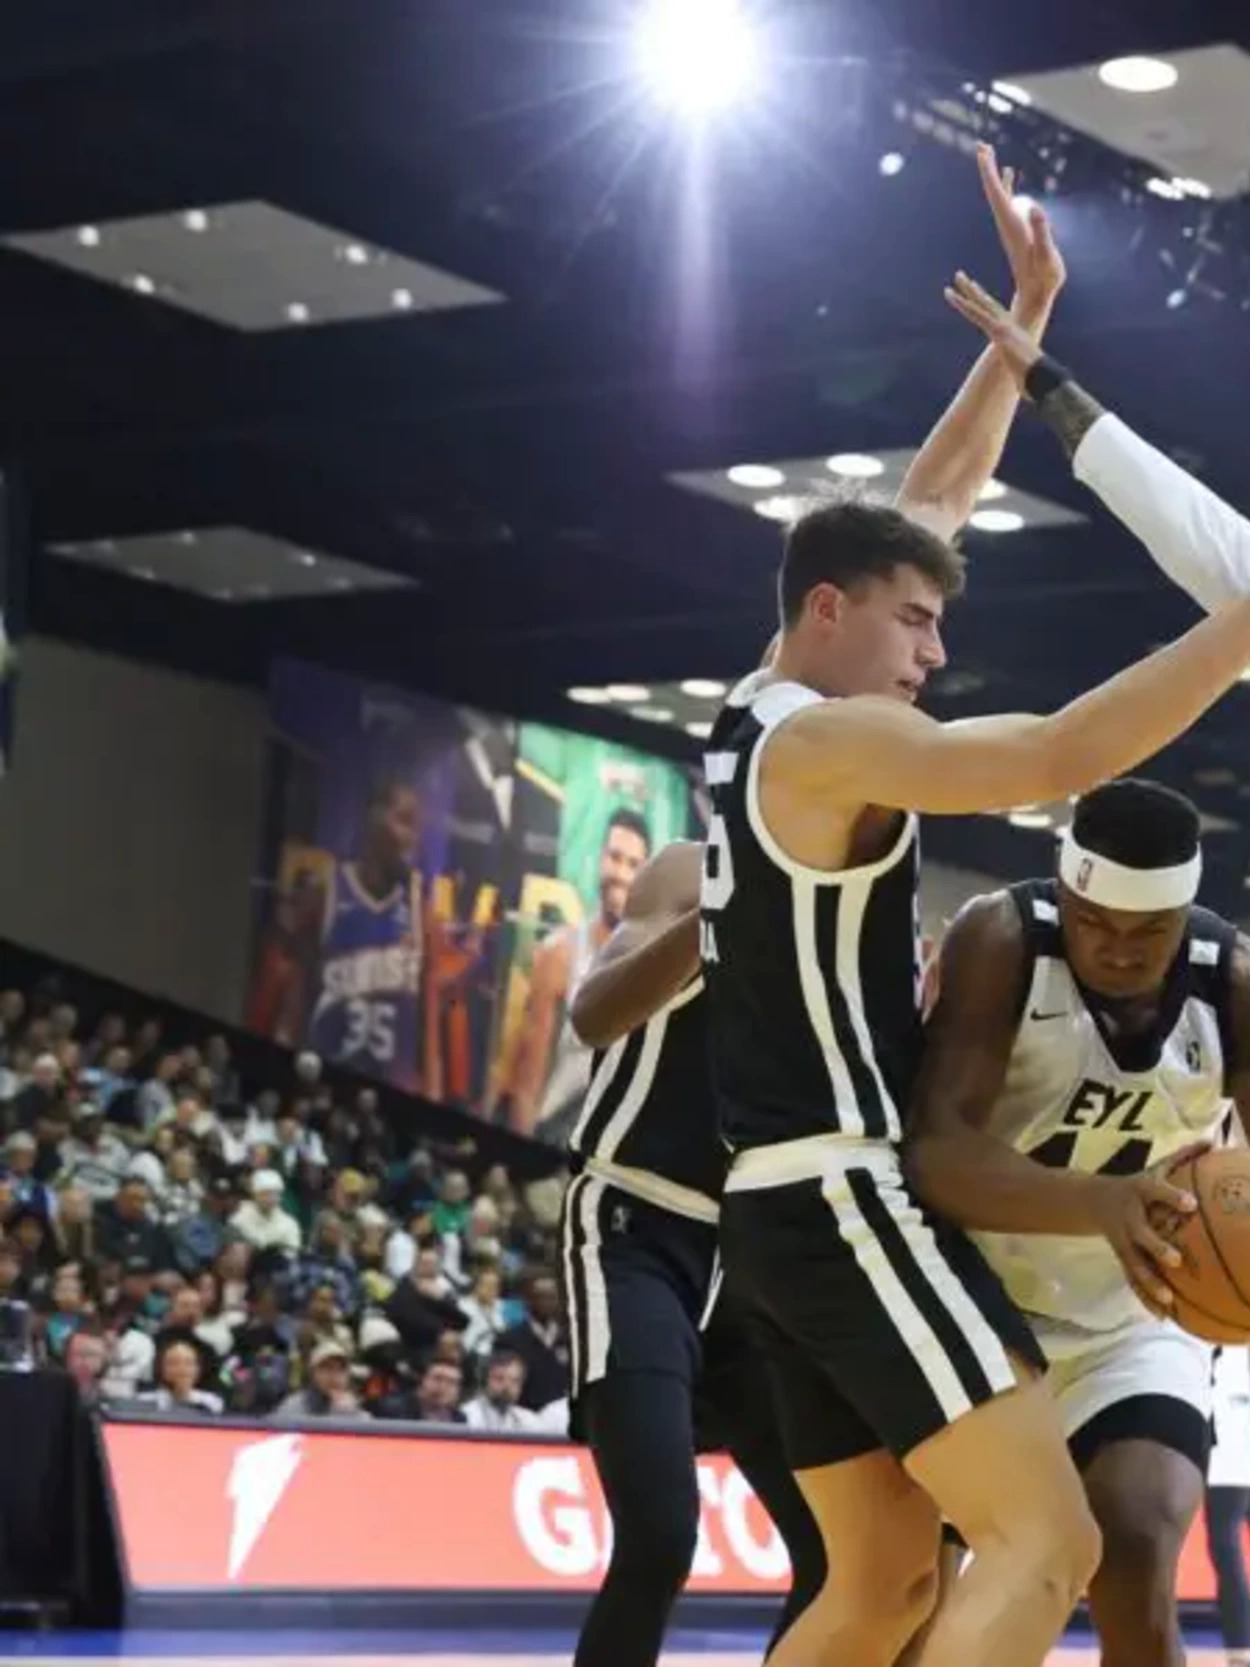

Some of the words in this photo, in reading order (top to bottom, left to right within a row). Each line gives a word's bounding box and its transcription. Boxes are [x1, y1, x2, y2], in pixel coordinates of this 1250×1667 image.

[338, 998, 398, 1063] 35
[1063, 1076, 1154, 1132] EYL
[511, 1455, 793, 1578] GO
